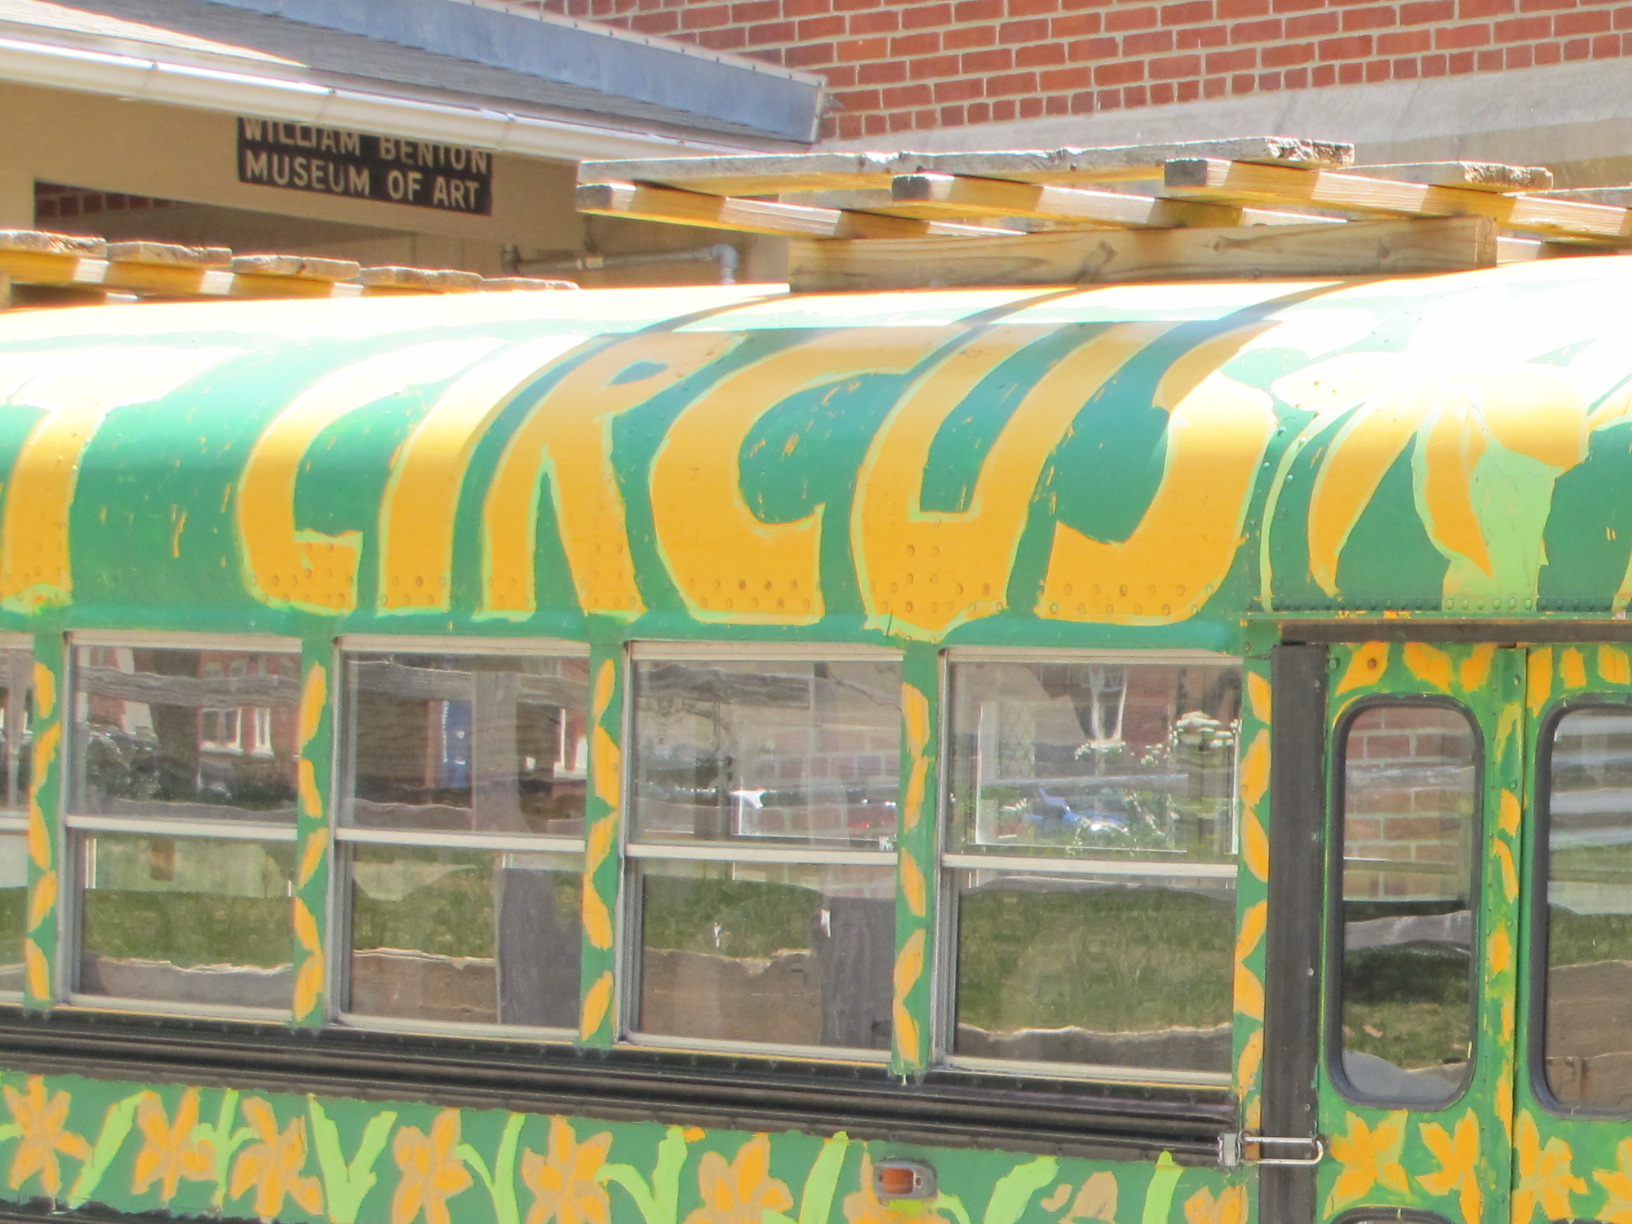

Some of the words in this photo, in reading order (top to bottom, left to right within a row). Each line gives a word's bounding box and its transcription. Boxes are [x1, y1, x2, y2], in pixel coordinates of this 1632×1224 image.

[243, 118, 361, 157] WILLIAM
[379, 134, 488, 175] BENTON
[246, 150, 370, 197] MUSEUM
[387, 169, 423, 201] OF
[432, 176, 480, 210] ART
